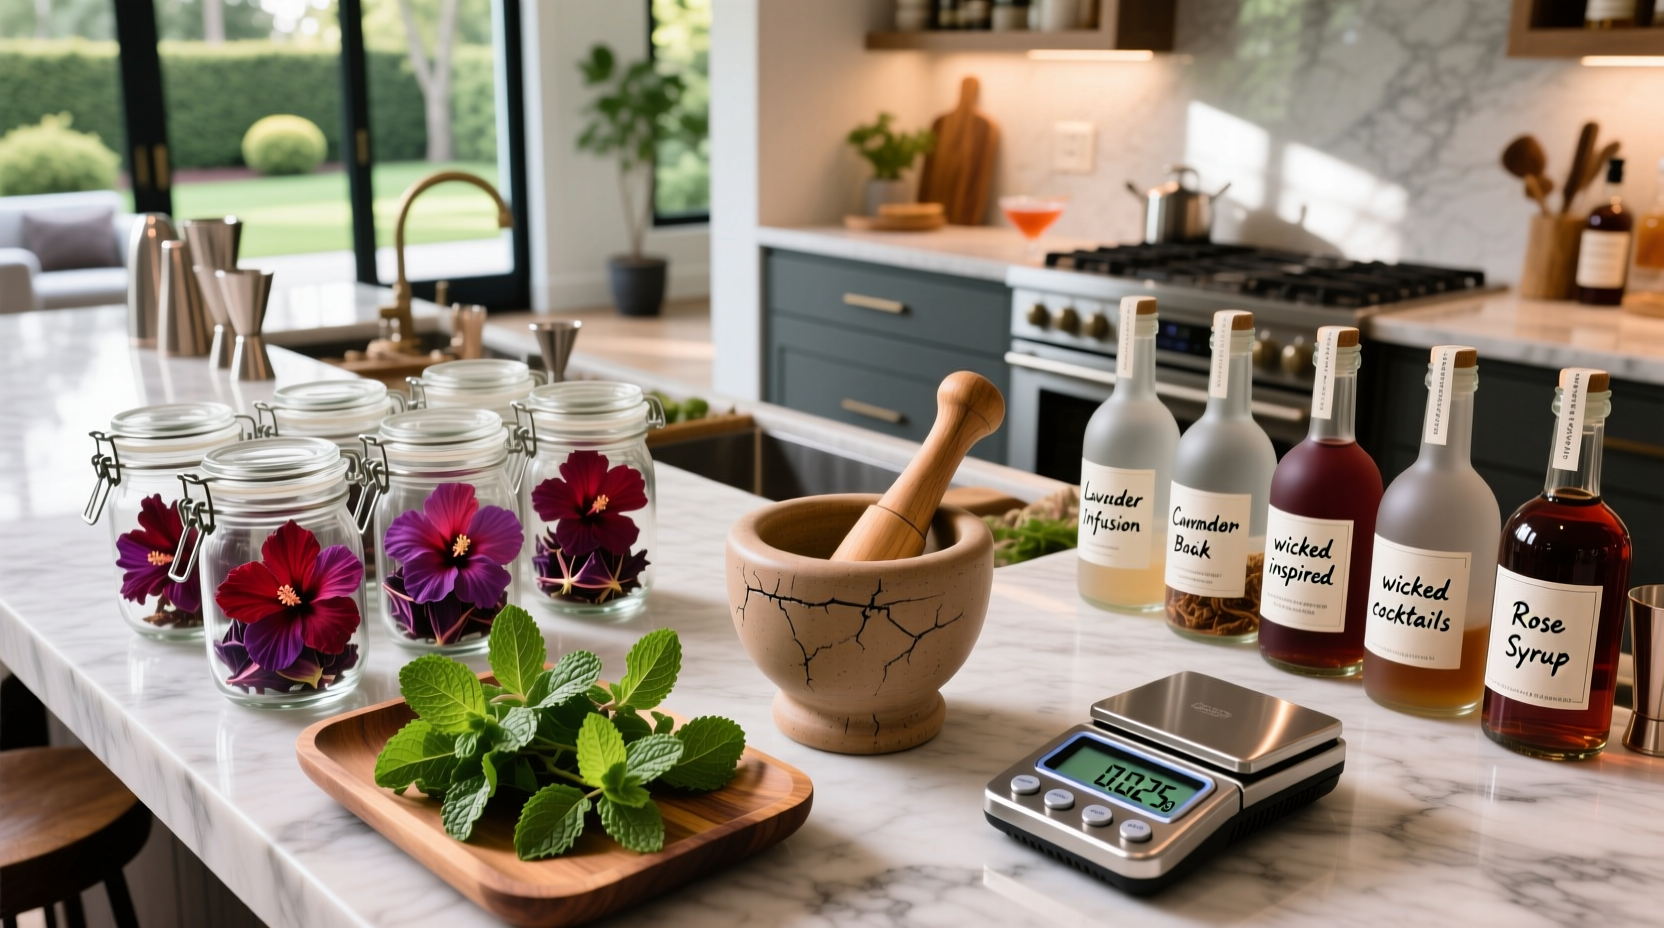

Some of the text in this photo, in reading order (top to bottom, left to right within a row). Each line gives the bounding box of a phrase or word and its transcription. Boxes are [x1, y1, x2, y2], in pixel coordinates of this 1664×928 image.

[1083, 508, 1140, 536] Infusion
[1273, 536, 1334, 560] wicked
[1269, 560, 1335, 587] inspired
[1382, 575, 1451, 601] wicked
[1372, 602, 1451, 632] cocktails
[1512, 601, 1566, 634] Rose
[1505, 635, 1570, 676] Syrup
